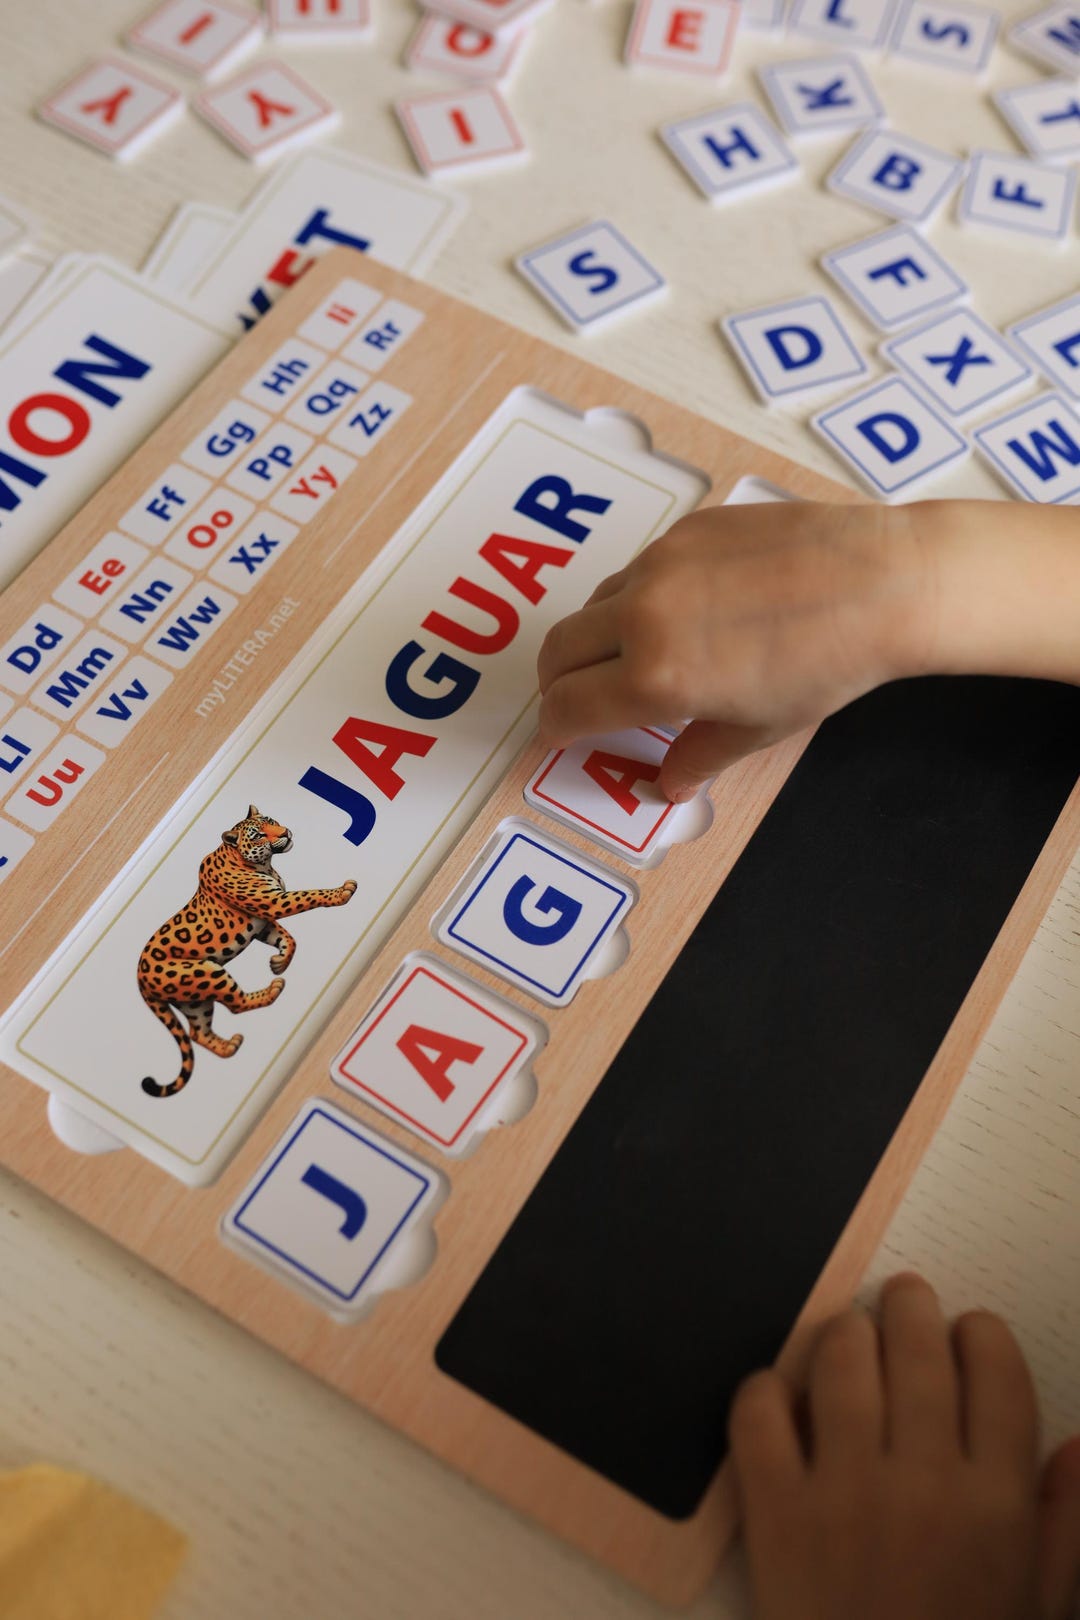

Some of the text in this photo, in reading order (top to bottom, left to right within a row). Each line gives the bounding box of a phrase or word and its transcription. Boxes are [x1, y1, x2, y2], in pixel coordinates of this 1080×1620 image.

[180, 14, 213, 46] I
[665, 9, 703, 51] E
[922, 21, 969, 45] S
[84, 88, 130, 124] Y
[249, 91, 293, 128] Y
[799, 79, 853, 111] K
[450, 109, 473, 144] I
[704, 128, 760, 169] H
[872, 153, 921, 192] B
[993, 179, 1043, 208] F
[568, 250, 618, 295] S
[868, 257, 926, 286] F
[764, 325, 823, 371] D
[926, 337, 992, 386] X
[856, 412, 920, 464] D
[1006, 419, 1080, 483] W
[7, 623, 63, 674] Dd
[79, 559, 126, 595] Ee
[146, 486, 186, 521] Ff
[207, 420, 256, 457] Gg
[262, 358, 309, 395] Hh
[46, 646, 114, 708] Mm
[119, 579, 174, 624] Nn
[187, 510, 233, 548] Oo
[247, 443, 293, 480] Pp
[306, 379, 358, 416] Qq
[364, 321, 402, 351] Rr
[26, 403, 392, 806] Uu Vv Ww Xx Yy Zz
[297, 474, 612, 847] JAGUAR
[302, 750, 662, 1240] J A G A
